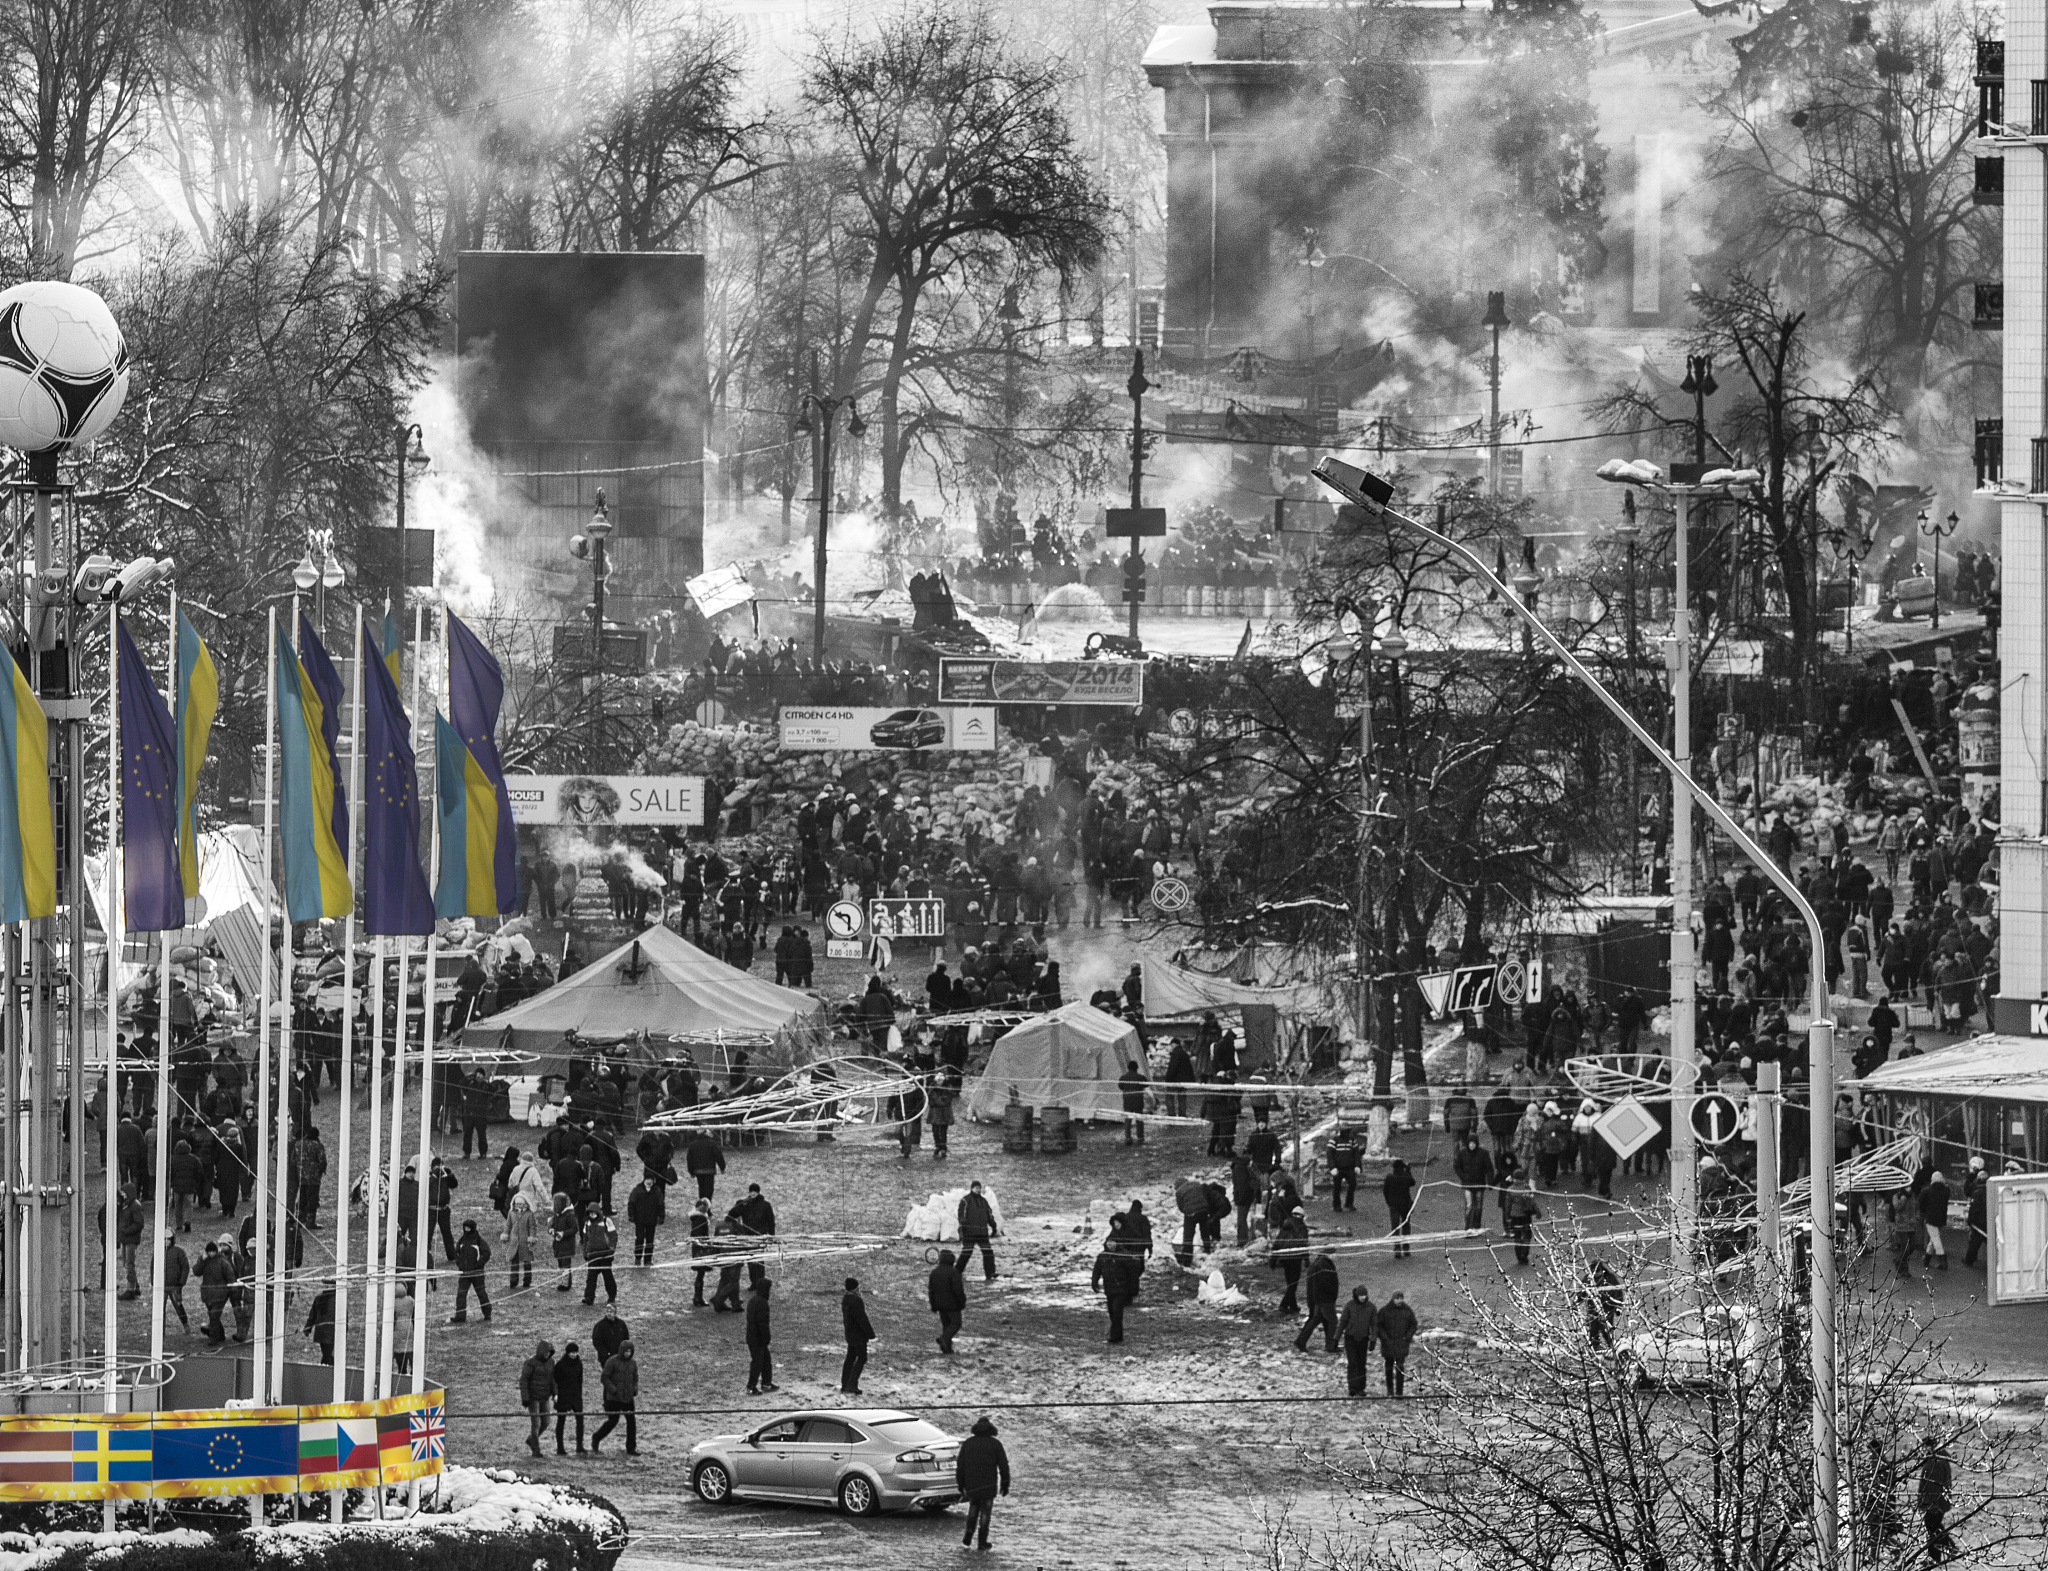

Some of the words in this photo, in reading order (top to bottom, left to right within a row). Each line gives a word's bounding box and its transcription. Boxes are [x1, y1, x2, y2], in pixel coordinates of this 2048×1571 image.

[1076, 665, 1133, 684] 2014
[825, 711, 836, 719] C4
[507, 791, 541, 800] HOUSE
[629, 788, 691, 812] SALE
